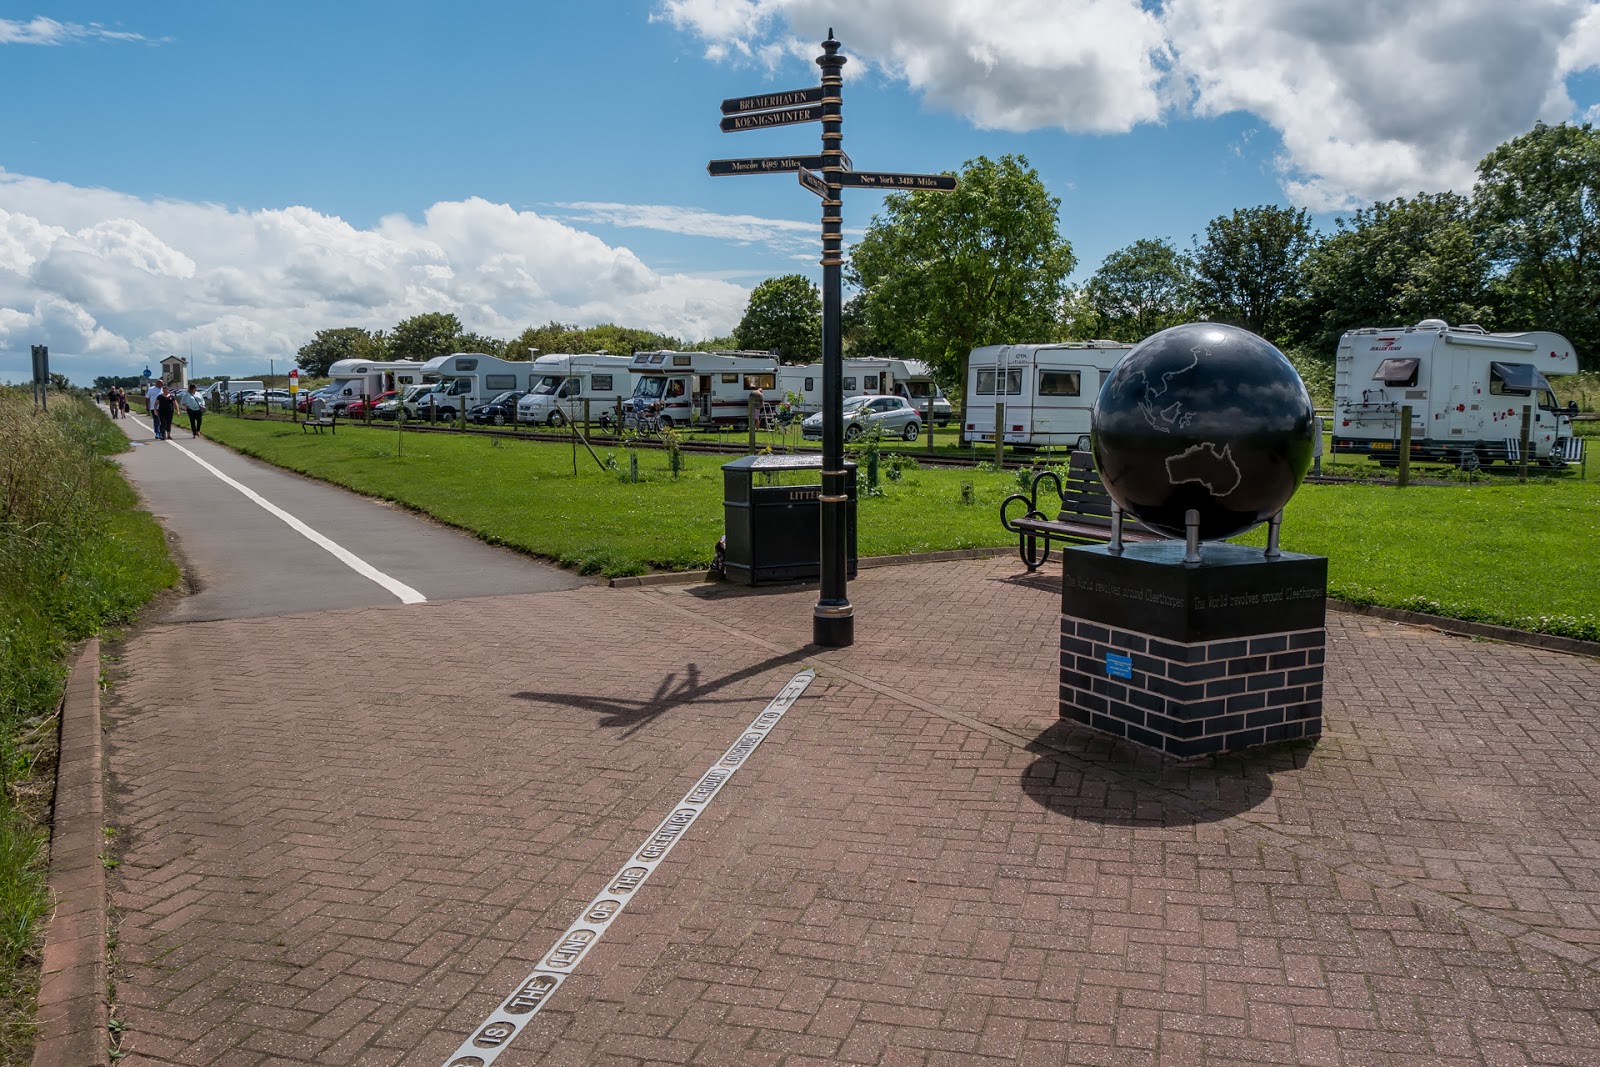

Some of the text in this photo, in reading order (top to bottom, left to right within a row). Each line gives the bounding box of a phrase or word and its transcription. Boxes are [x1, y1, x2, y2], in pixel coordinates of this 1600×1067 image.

[740, 92, 807, 110] BREMERHAVEN
[735, 110, 811, 128] KOENIGSWINTER
[732, 161, 759, 171] Moscow
[781, 158, 801, 168] Miles
[861, 175, 938, 186] New York 3418 Miles
[1065, 574, 1185, 609] The World revolves around Cleethorpes
[1194, 586, 1323, 610] The World revolves around Cleethorpes
[478, 1028, 508, 1043] IS
[511, 981, 552, 1008] THE
[550, 934, 591, 963] LINE
[590, 904, 613, 919] OF
[612, 870, 644, 890] THE
[643, 812, 692, 858] GREENWICH
